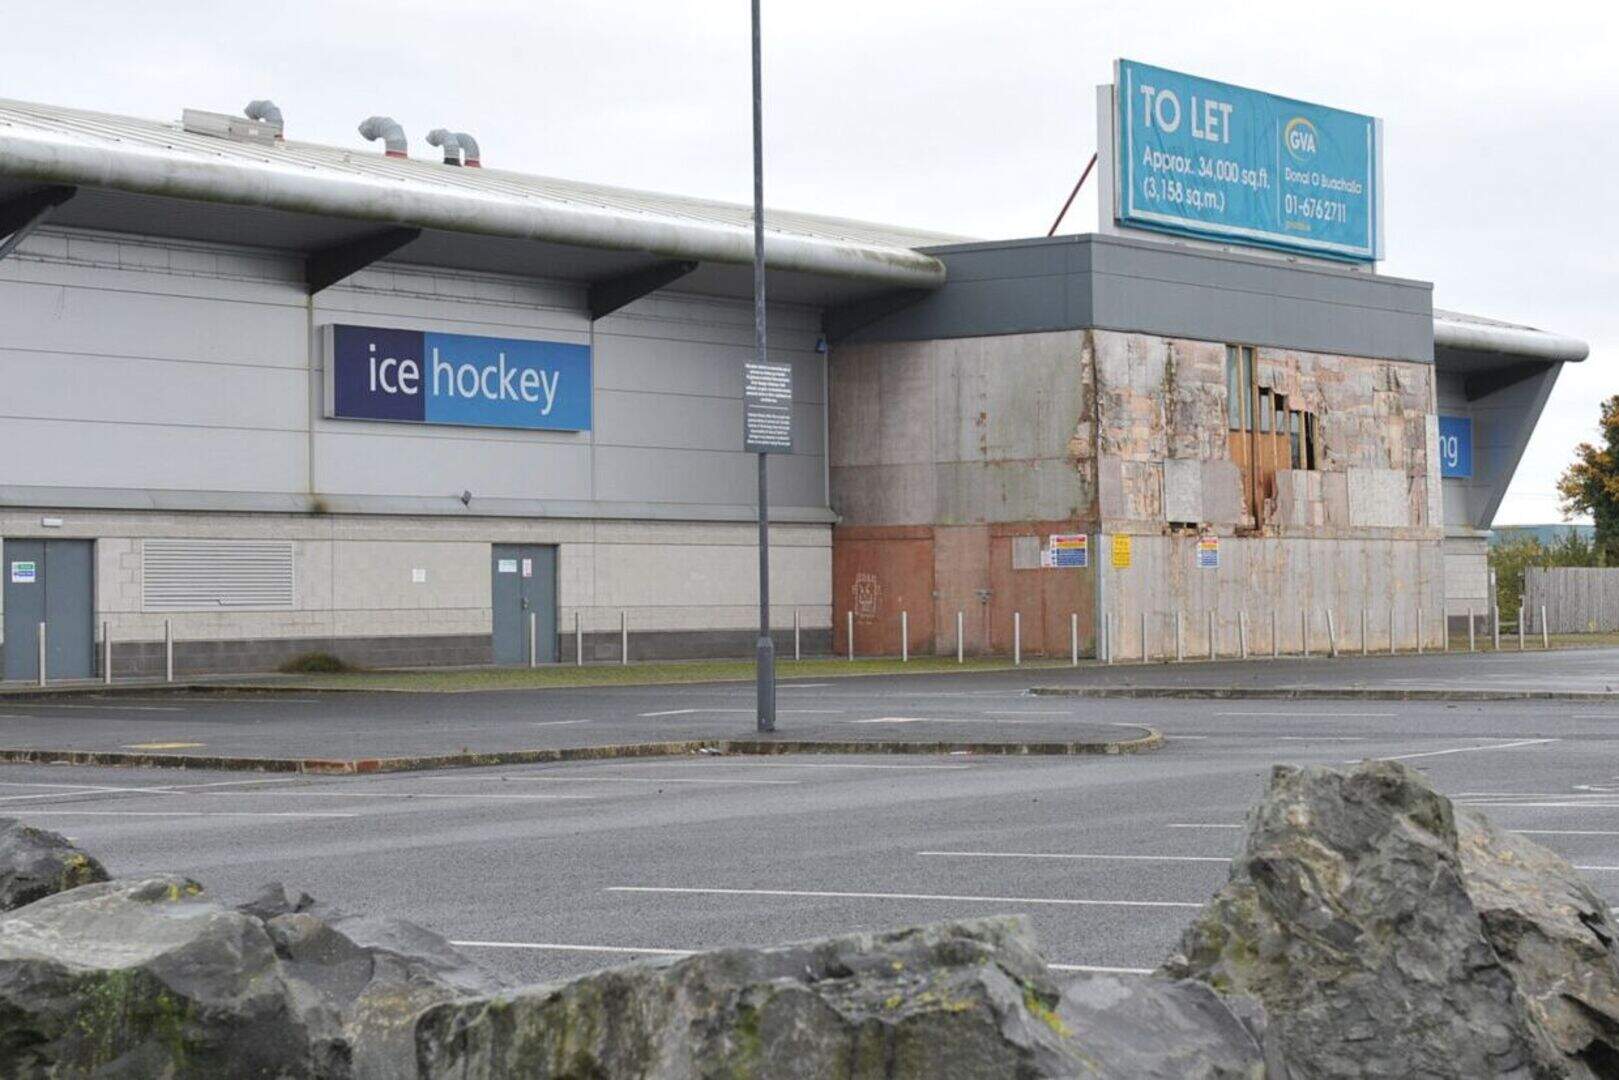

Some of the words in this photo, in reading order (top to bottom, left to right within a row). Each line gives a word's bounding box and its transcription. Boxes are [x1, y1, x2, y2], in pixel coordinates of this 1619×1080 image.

[1140, 84, 1182, 134] TO
[1191, 96, 1233, 143] LET
[1288, 130, 1316, 154] GVA
[1142, 145, 1195, 174] Approx.
[1198, 156, 1239, 183] 34,000
[1143, 176, 1184, 204] (3,158
[1186, 188, 1226, 213] sq.m.)
[369, 343, 419, 396] ice
[432, 347, 559, 416] hockey
